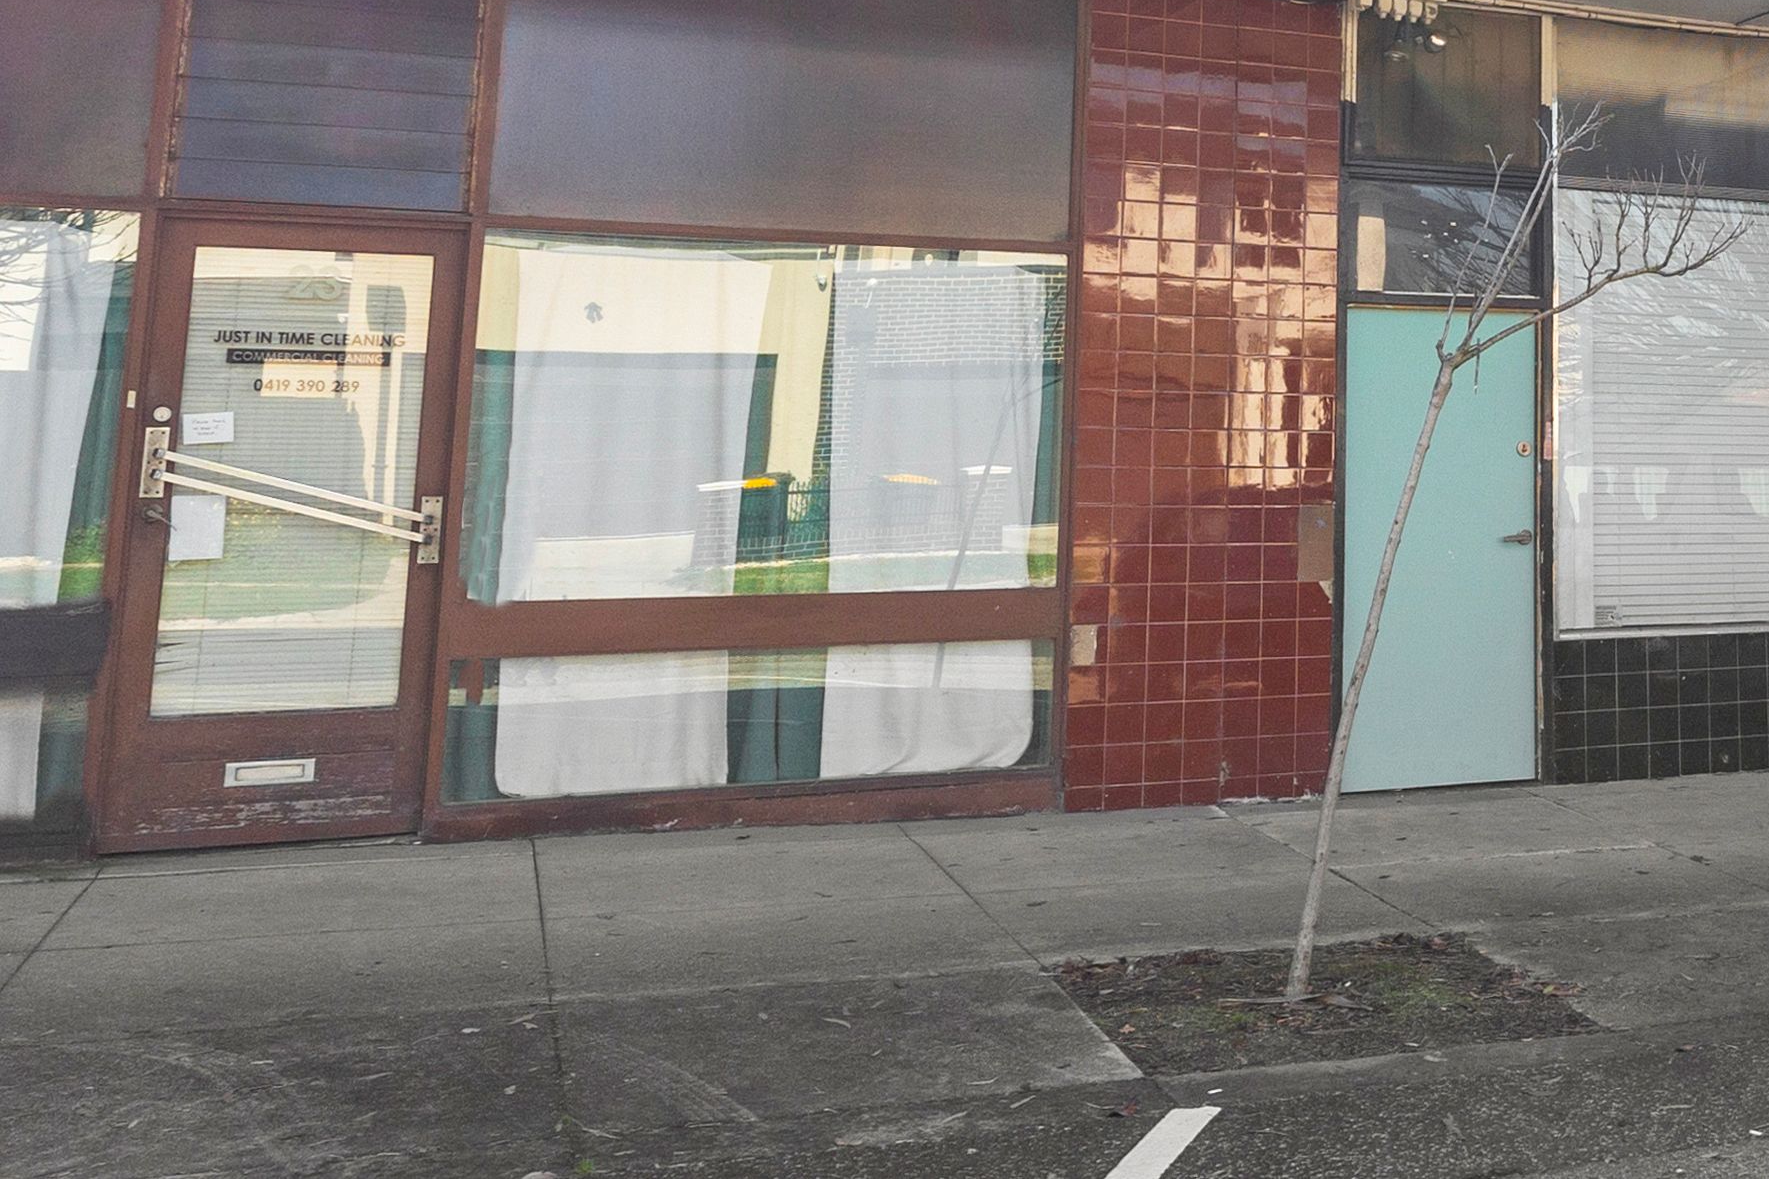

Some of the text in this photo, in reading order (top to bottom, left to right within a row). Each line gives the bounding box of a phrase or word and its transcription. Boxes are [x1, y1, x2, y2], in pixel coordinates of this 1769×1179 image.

[213, 330, 406, 347] JUST IN TIME CLEANING
[231, 350, 385, 364] COMMERCIAL CLEANING
[253, 379, 360, 393] 0419 390 289
